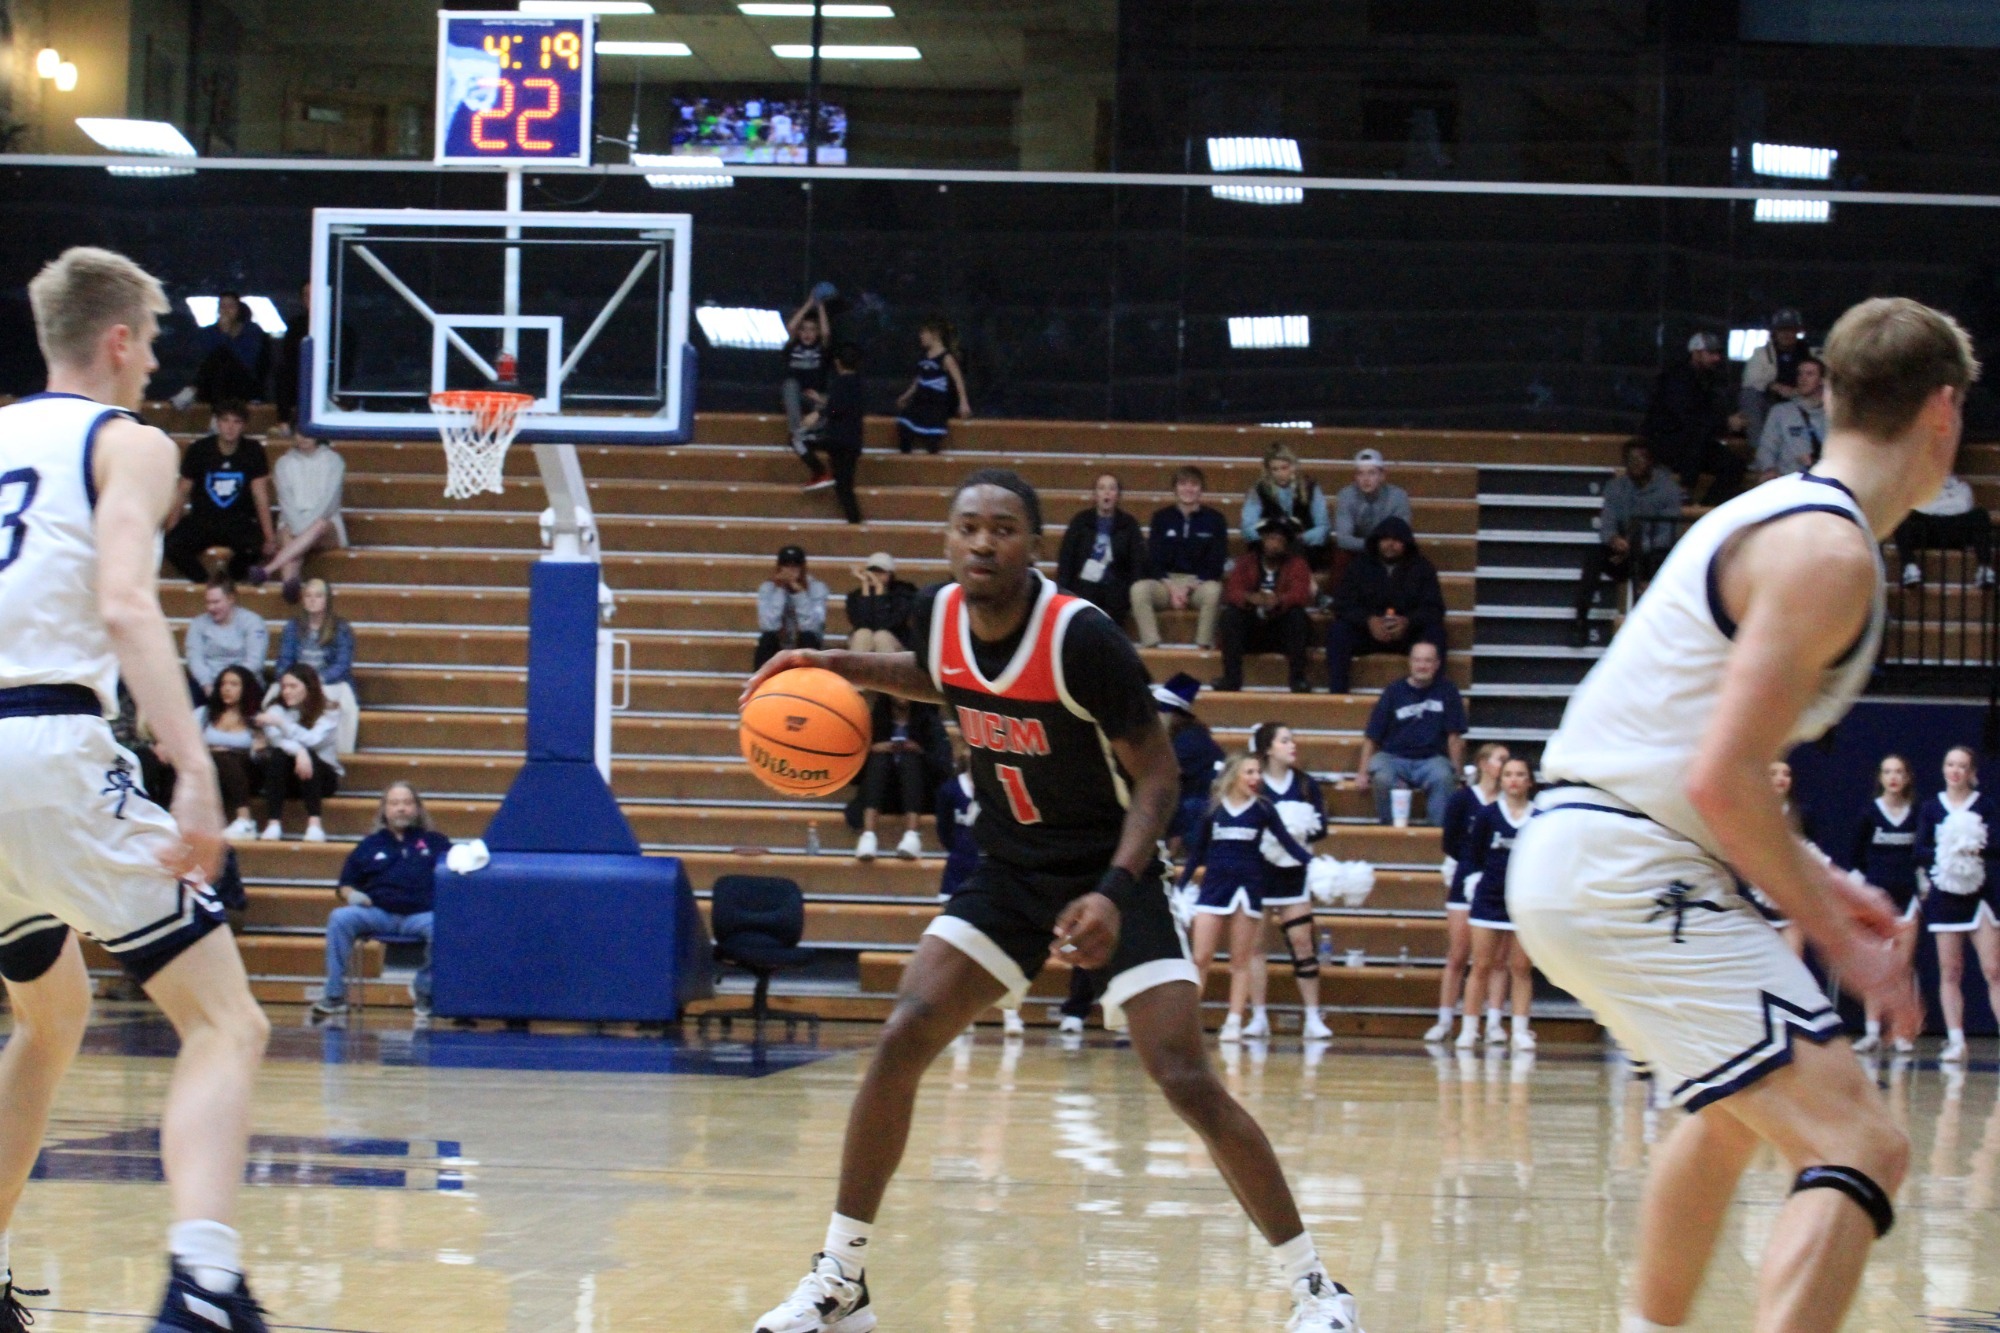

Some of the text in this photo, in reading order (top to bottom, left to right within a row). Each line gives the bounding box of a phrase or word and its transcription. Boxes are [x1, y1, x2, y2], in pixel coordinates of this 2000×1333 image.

[484, 31, 580, 70] 4:19
[470, 78, 561, 151] 22
[955, 704, 1052, 757] UCM
[751, 741, 829, 781] Wilson
[994, 763, 1043, 825] 1
